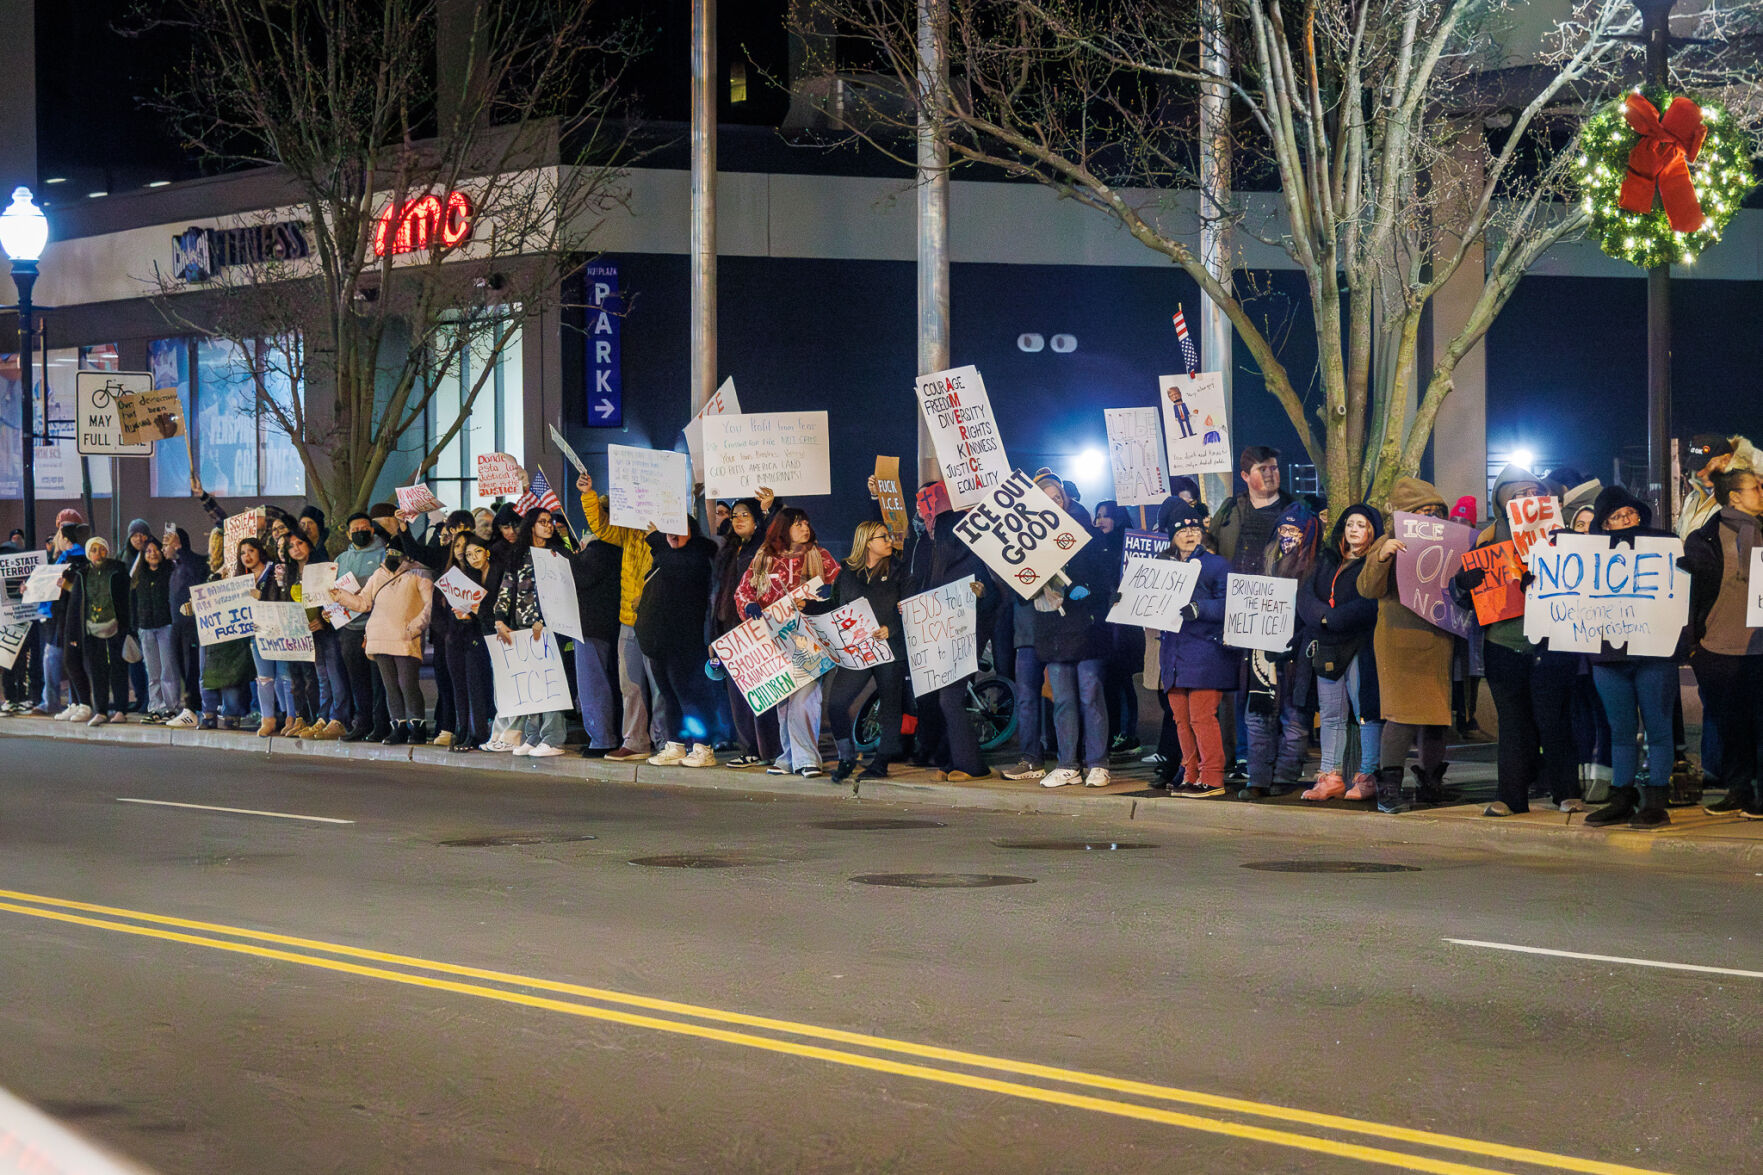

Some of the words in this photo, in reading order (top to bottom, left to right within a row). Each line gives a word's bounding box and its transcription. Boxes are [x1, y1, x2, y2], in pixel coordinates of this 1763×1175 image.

[594, 283, 613, 392] PARK
[923, 376, 966, 397] COURAGE
[924, 392, 961, 415] FREEDOM
[89, 415, 112, 427] MAY
[938, 404, 986, 429] DIVERSITY
[84, 434, 111, 446] FULL
[959, 421, 992, 441] RIGHTS
[957, 437, 997, 459] KINDNESS
[946, 457, 984, 478] JUSTICE
[878, 480, 898, 493] FUCK
[957, 471, 999, 494] EQUALITY
[955, 503, 1002, 544] ICE
[994, 470, 1034, 509] OUT
[1509, 496, 1554, 526] ICE
[992, 503, 1039, 545] FOR
[1403, 519, 1445, 541] ICE
[1001, 510, 1060, 565] GOOD
[1125, 536, 1152, 551] HATE
[15, 556, 39, 567] STATE
[1129, 564, 1187, 593] ABOLISH
[1232, 579, 1274, 596] BRINGING
[900, 591, 942, 625] JESUS
[1131, 594, 1172, 616] ICE!!
[1244, 597, 1259, 610] THE
[1413, 588, 1473, 631] NOW
[1550, 600, 1614, 622] Welcome
[1620, 604, 1635, 618] in
[200, 611, 222, 629] NOT
[1228, 612, 1258, 634] MELT
[1261, 615, 1288, 635] ICE!!
[215, 624, 239, 639] FUCK
[715, 619, 766, 661] STATE
[1573, 620, 1651, 643] Morristown
[500, 632, 555, 669] FUCK
[911, 649, 929, 668] NOT
[511, 668, 561, 706] ICE
[747, 671, 796, 713] CHILDREN
